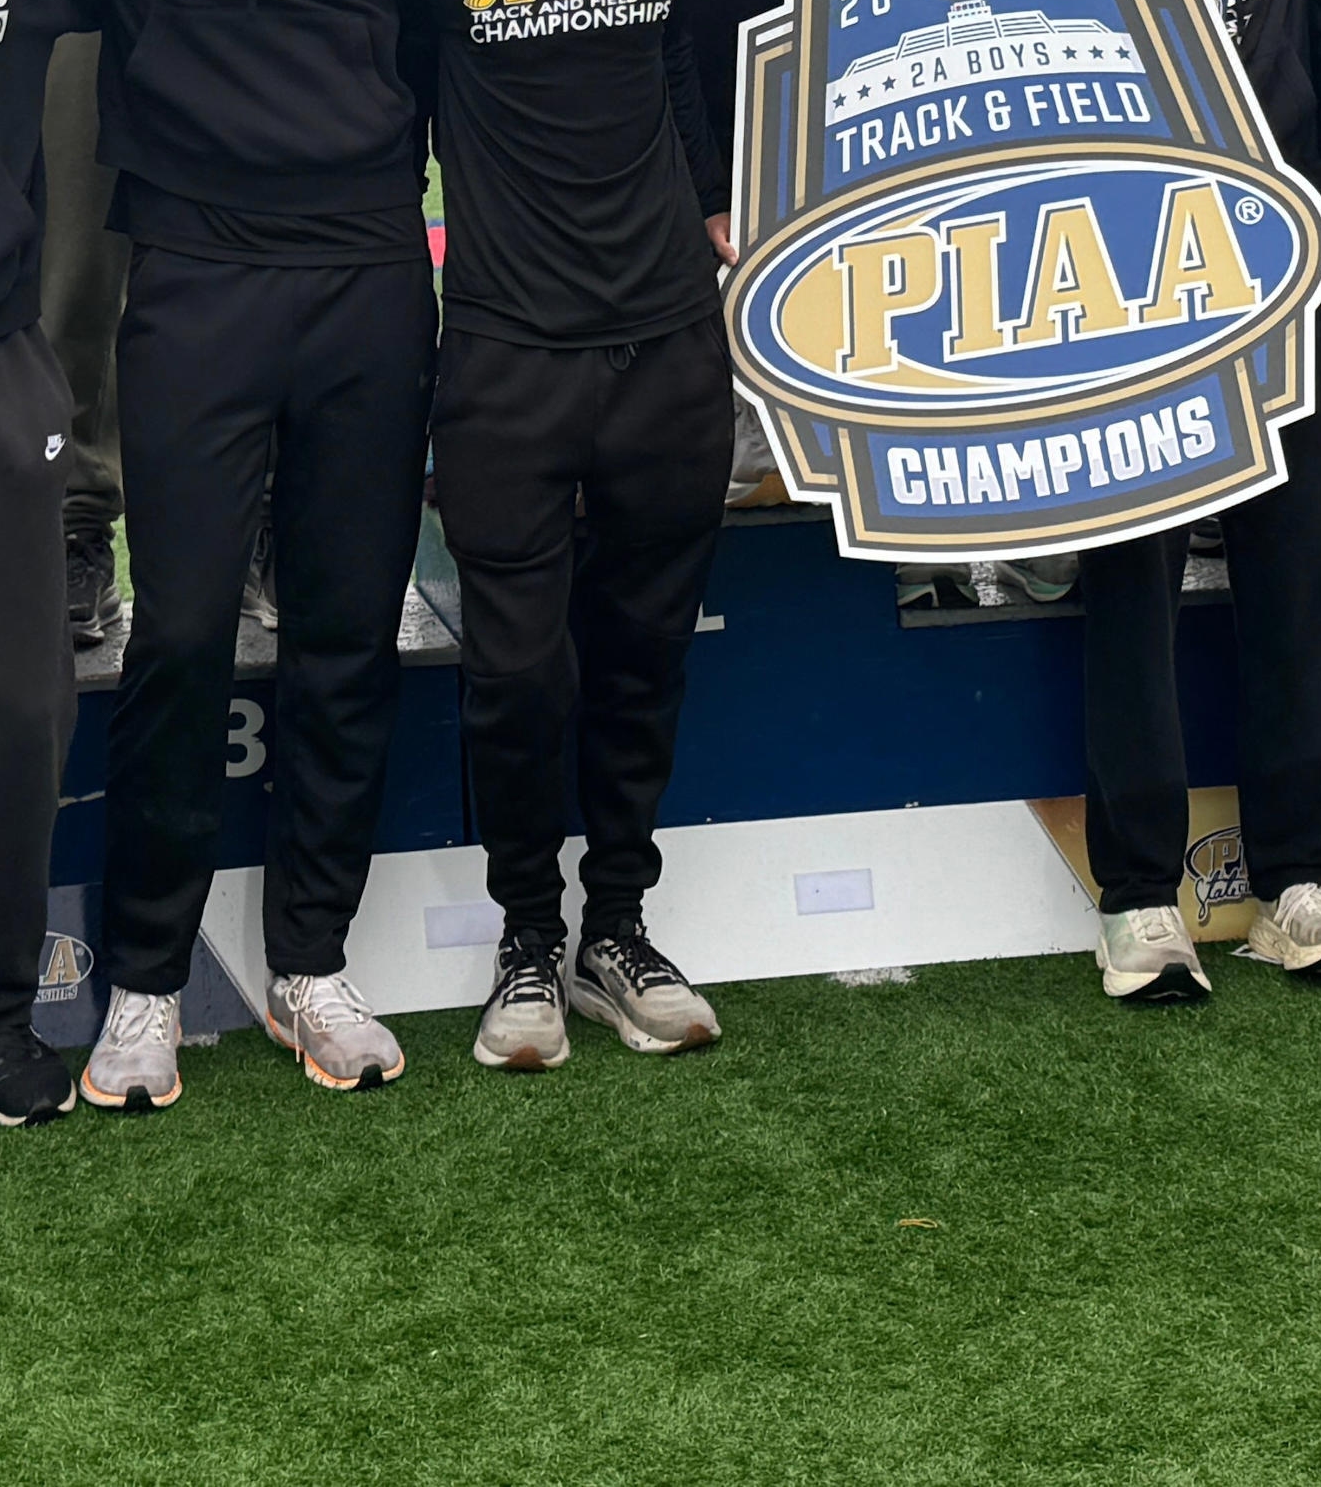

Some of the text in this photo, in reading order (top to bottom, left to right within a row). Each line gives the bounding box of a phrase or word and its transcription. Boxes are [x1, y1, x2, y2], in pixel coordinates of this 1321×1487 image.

[469, 0, 672, 45] CHAMPIONSHIPS
[470, 4, 534, 25] TRACK
[910, 40, 1051, 88] 2A BOYS
[834, 81, 1152, 174] TRACK & FIELD
[886, 394, 1219, 507] CHAMPIONS
[225, 697, 267, 778] 3
